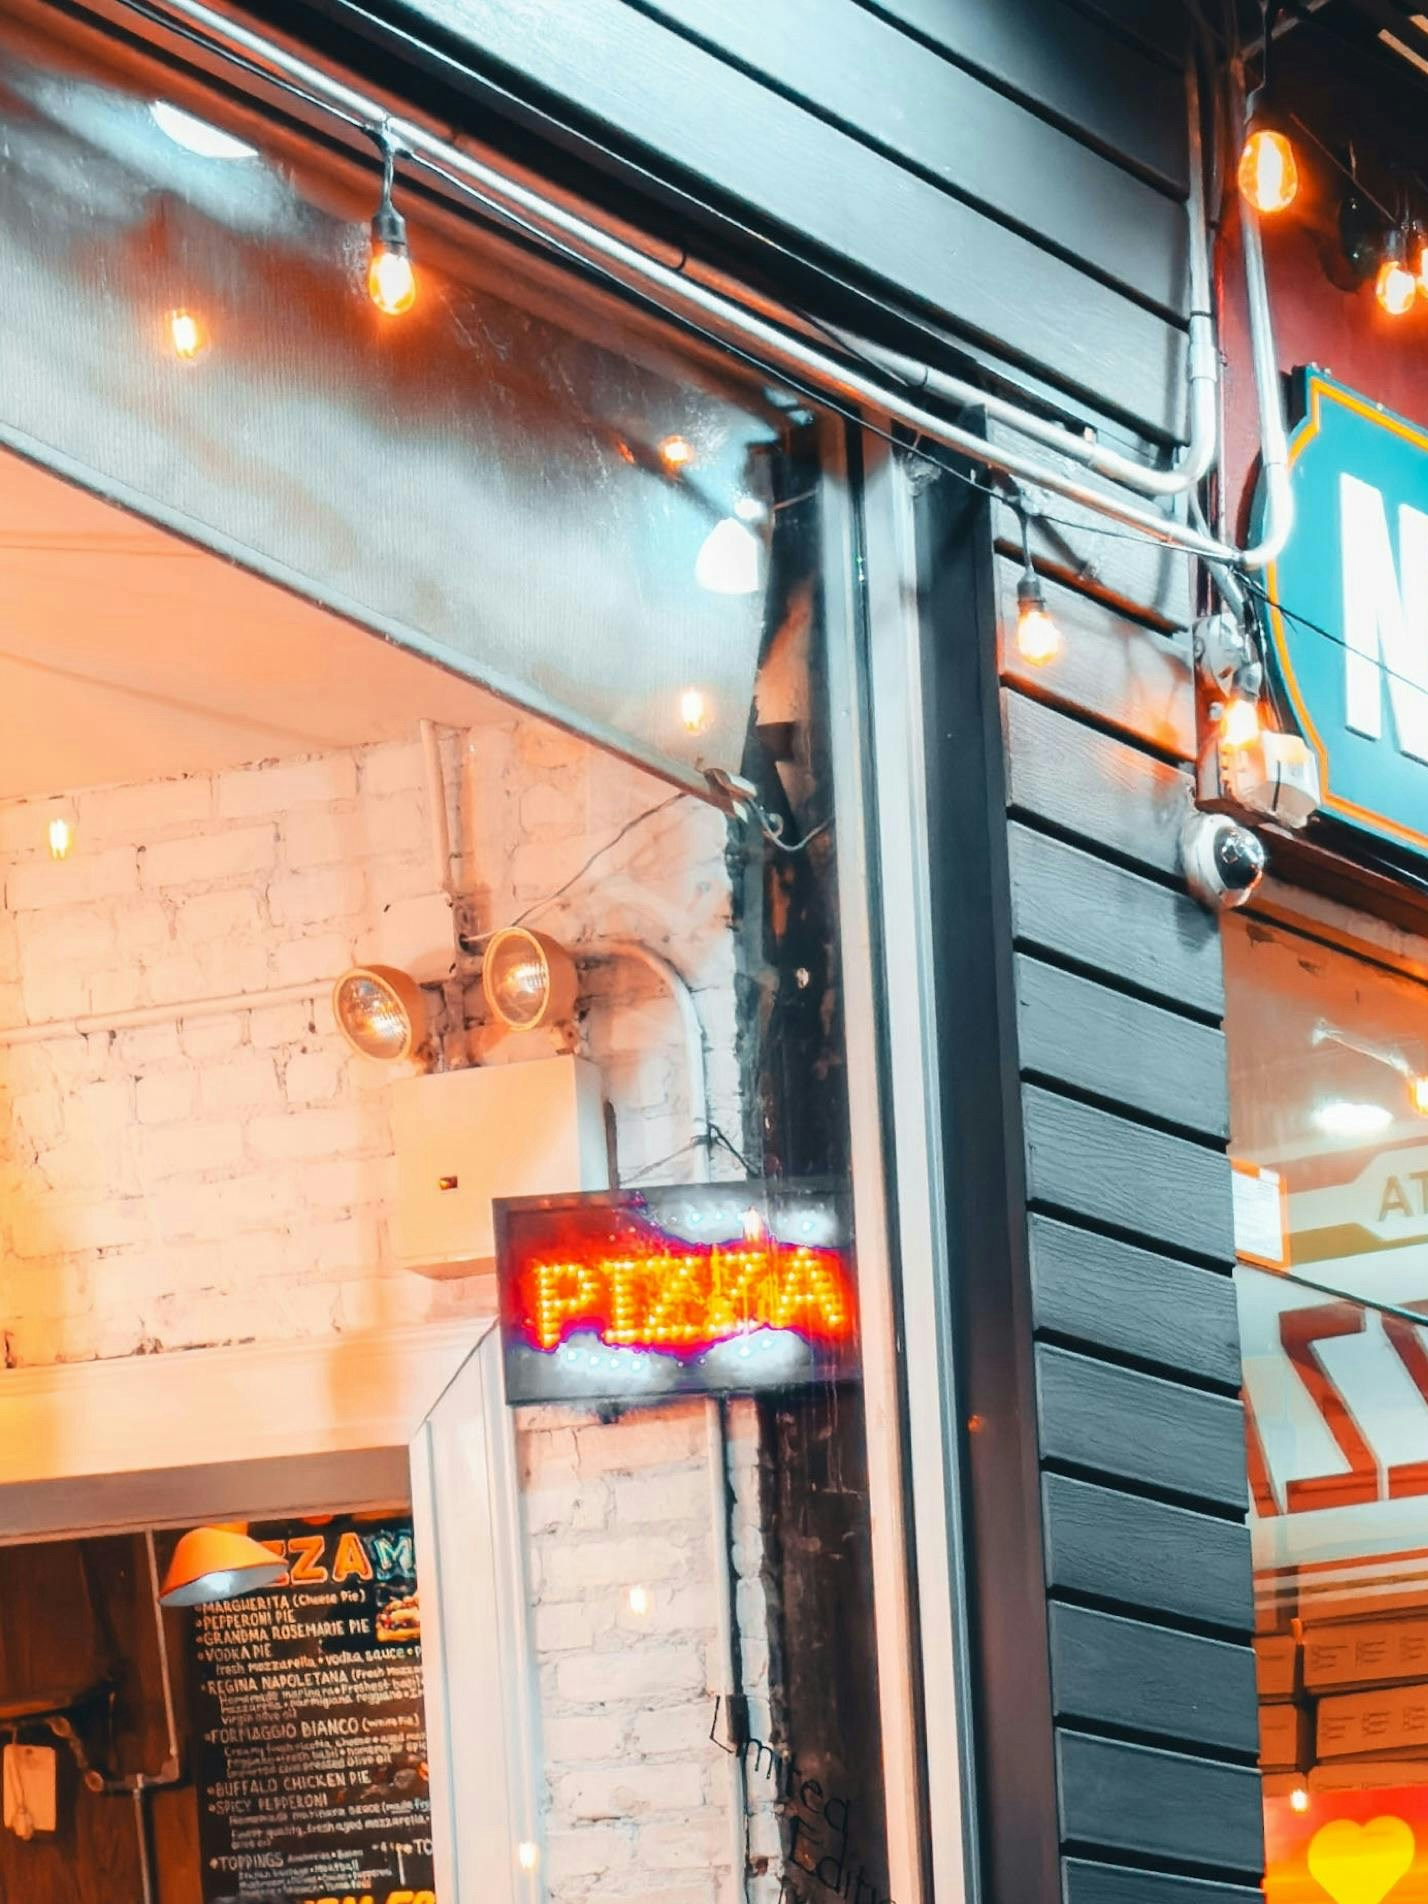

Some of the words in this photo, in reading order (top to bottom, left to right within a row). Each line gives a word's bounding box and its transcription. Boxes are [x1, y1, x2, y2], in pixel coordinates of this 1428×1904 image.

[536, 1246, 842, 1346] PIZZA
[203, 1612, 272, 1630] PEPPERONI
[275, 1609, 295, 1623] PIE
[203, 1629, 268, 1647] GRANDMA
[272, 1620, 344, 1640] ROSEMARIE
[349, 1618, 369, 1634] PIE
[205, 1646, 251, 1663] VODKA
[252, 1643, 272, 1659] PIE
[207, 1676, 258, 1696] REGINA
[262, 1669, 348, 1690] NAPOLETANA
[301, 1717, 360, 1738] BIANCO
[215, 1779, 278, 1798] BUFFALO
[283, 1773, 346, 1792] CHICKEN
[349, 1770, 372, 1786] PIE
[220, 1852, 285, 1871] TOPPINGS
